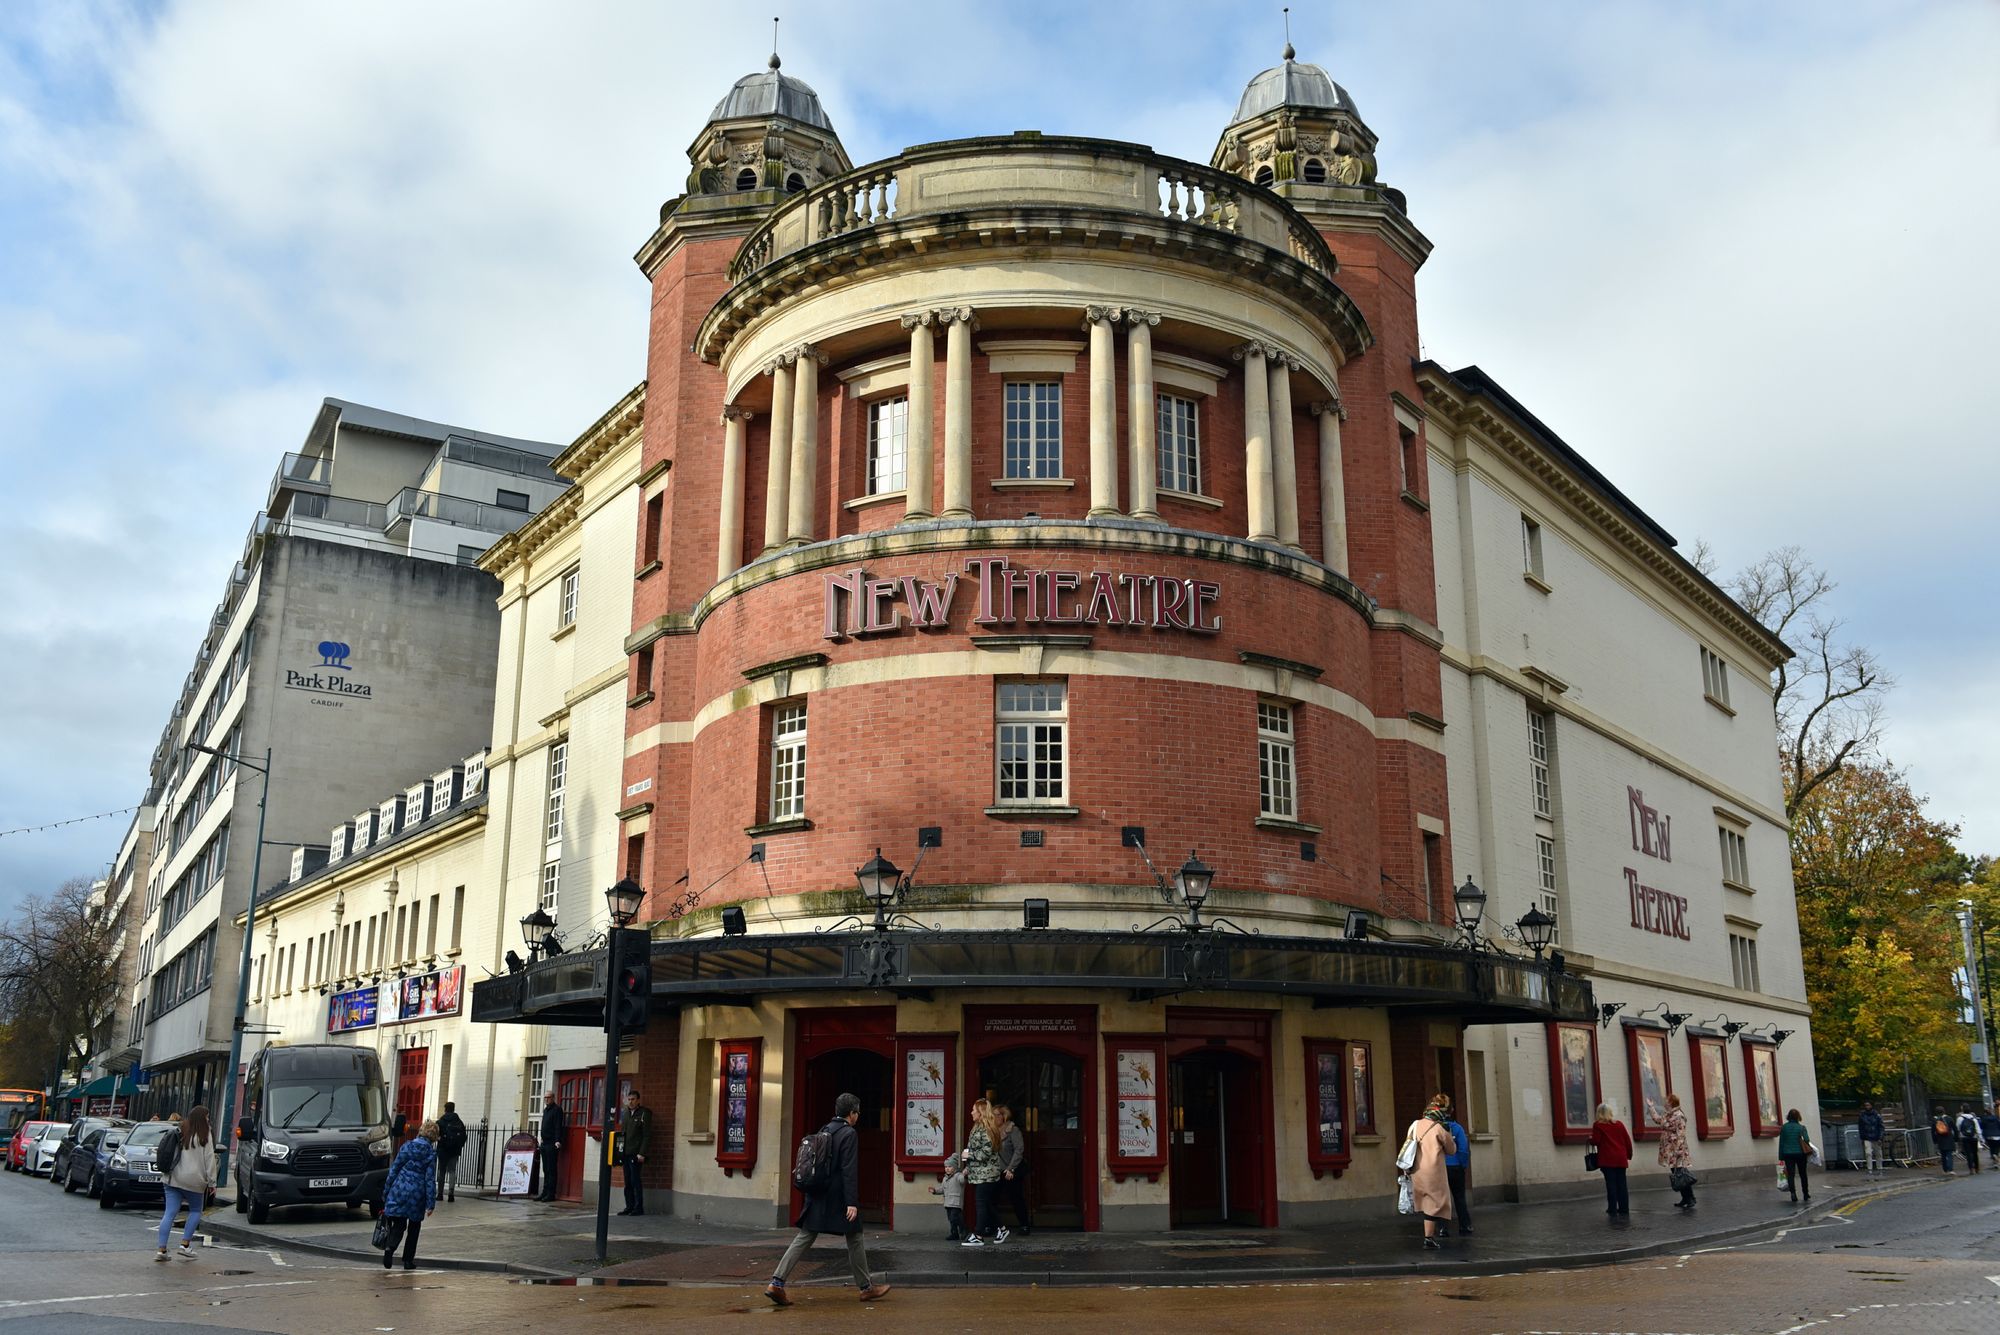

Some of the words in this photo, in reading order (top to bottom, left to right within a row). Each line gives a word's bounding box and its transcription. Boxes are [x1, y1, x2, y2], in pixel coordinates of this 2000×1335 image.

[963, 555, 1222, 633] THEATRE
[286, 669, 324, 690] Park
[327, 675, 372, 696] Plaza
[310, 698, 344, 708] CARDIFF
[1626, 784, 1672, 863] NEW
[1623, 866, 1691, 941] THEATRE
[908, 1138, 938, 1148] WRONG
[1119, 1139, 1150, 1149] WRONG
